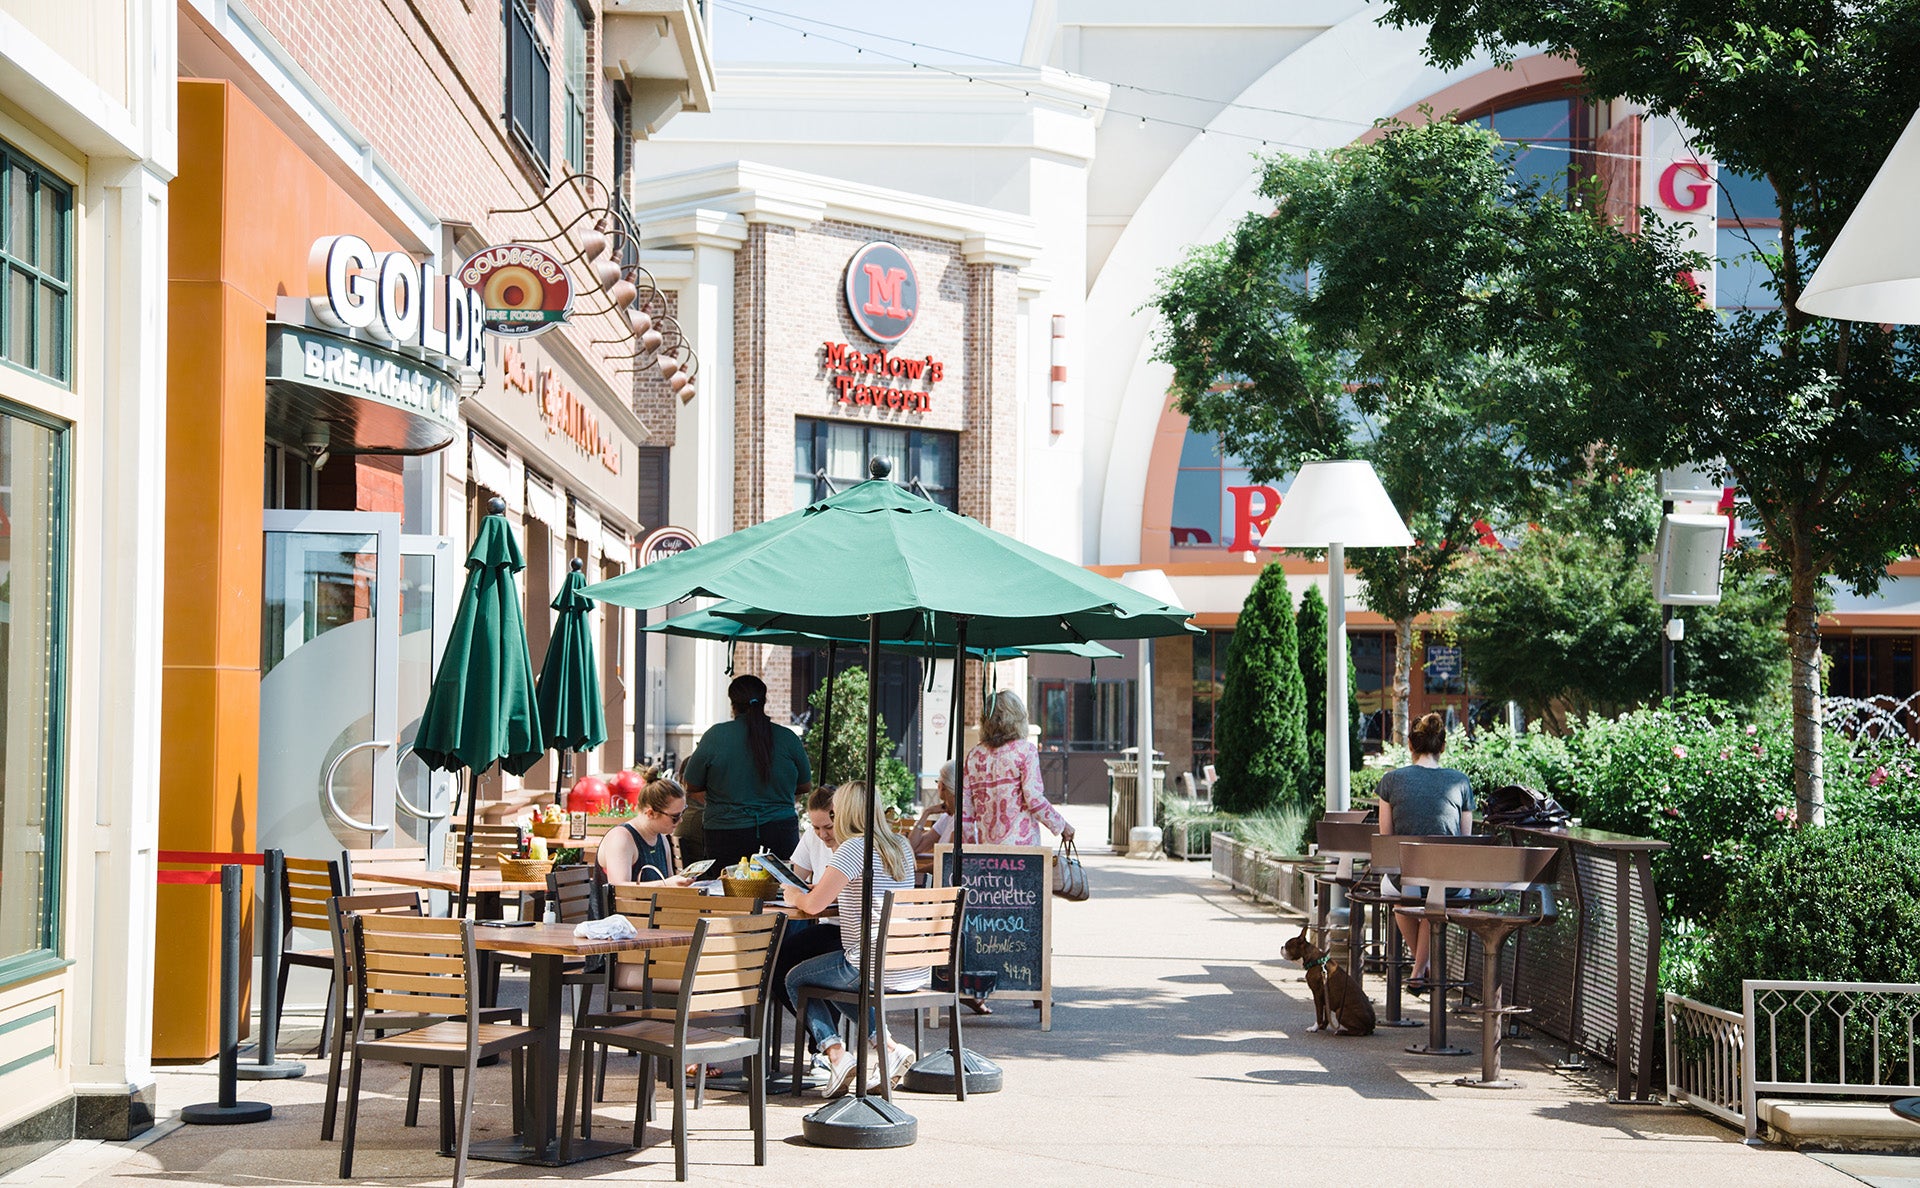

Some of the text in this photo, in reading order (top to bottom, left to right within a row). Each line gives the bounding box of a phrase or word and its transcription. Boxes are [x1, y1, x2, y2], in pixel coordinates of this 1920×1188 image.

[463, 247, 565, 286] GOLDBERGS
[324, 234, 485, 374] GOLDB
[510, 310, 545, 321] FOODS
[304, 340, 431, 409] BREAKFAST
[824, 341, 944, 382] Marlow's
[836, 376, 932, 412] Tavern
[967, 888, 1036, 905] Omelette
